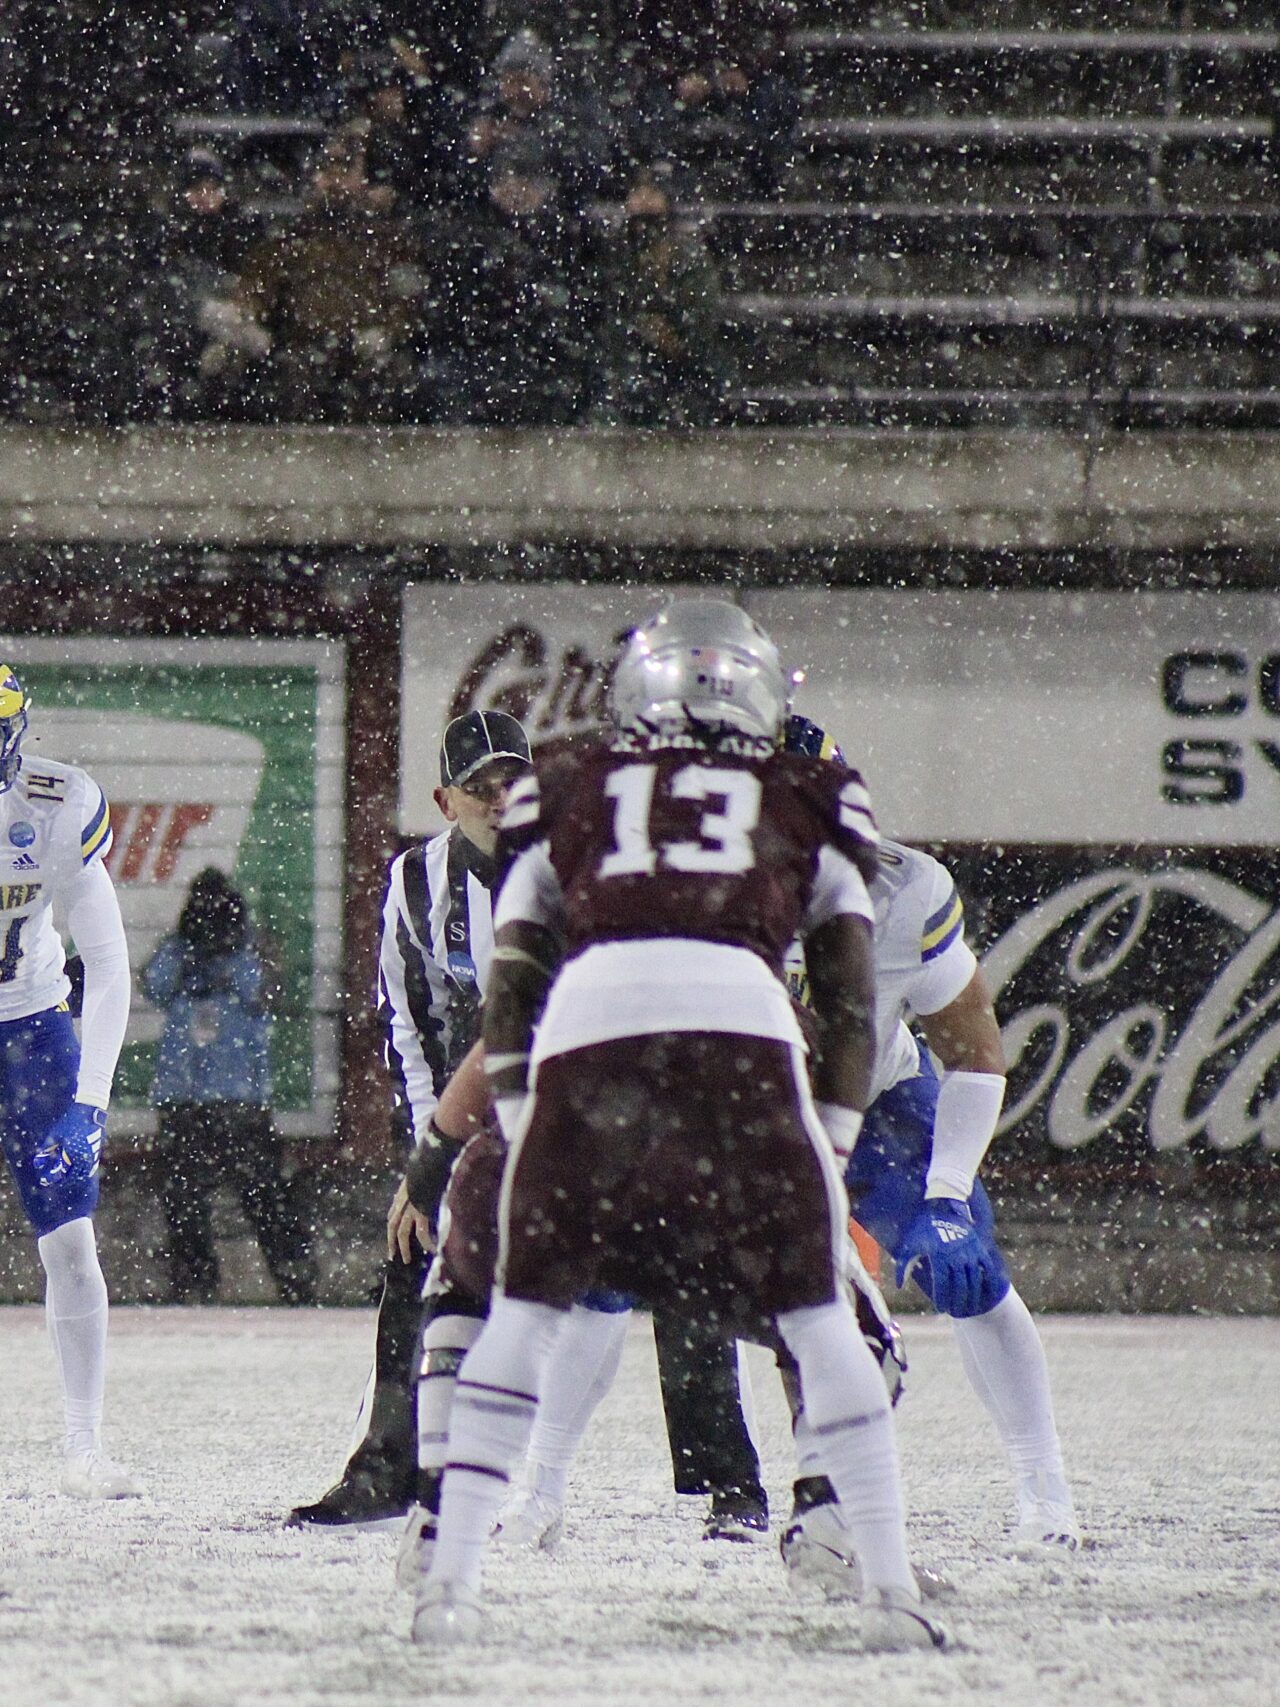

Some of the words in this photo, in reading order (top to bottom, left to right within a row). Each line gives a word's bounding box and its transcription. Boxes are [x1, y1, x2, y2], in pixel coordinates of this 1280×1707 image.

[27, 774, 64, 802] 14
[597, 763, 763, 880] 13
[450, 921, 466, 941] S
